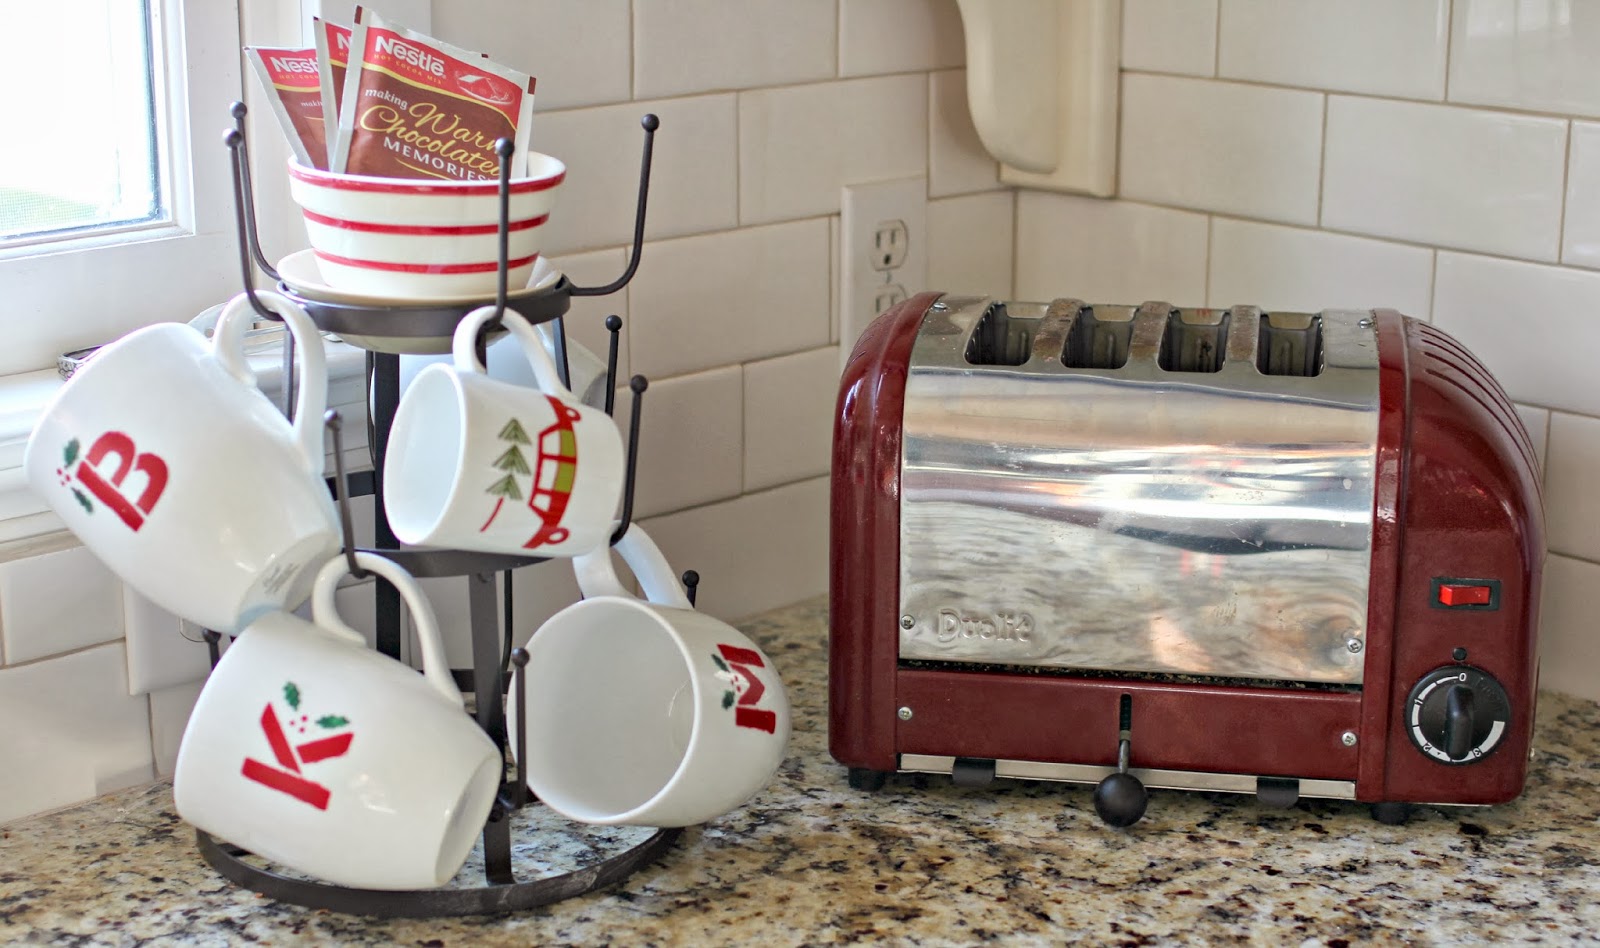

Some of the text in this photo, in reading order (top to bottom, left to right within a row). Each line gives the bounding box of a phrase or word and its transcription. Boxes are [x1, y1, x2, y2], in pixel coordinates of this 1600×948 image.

[269, 56, 319, 73] Nest
[374, 53, 392, 61] HOT
[365, 88, 408, 110] making
[76, 431, 169, 532] B
[1423, 742, 1433, 752] 2
[1473, 748, 1481, 757] 3
[241, 701, 354, 811] K
